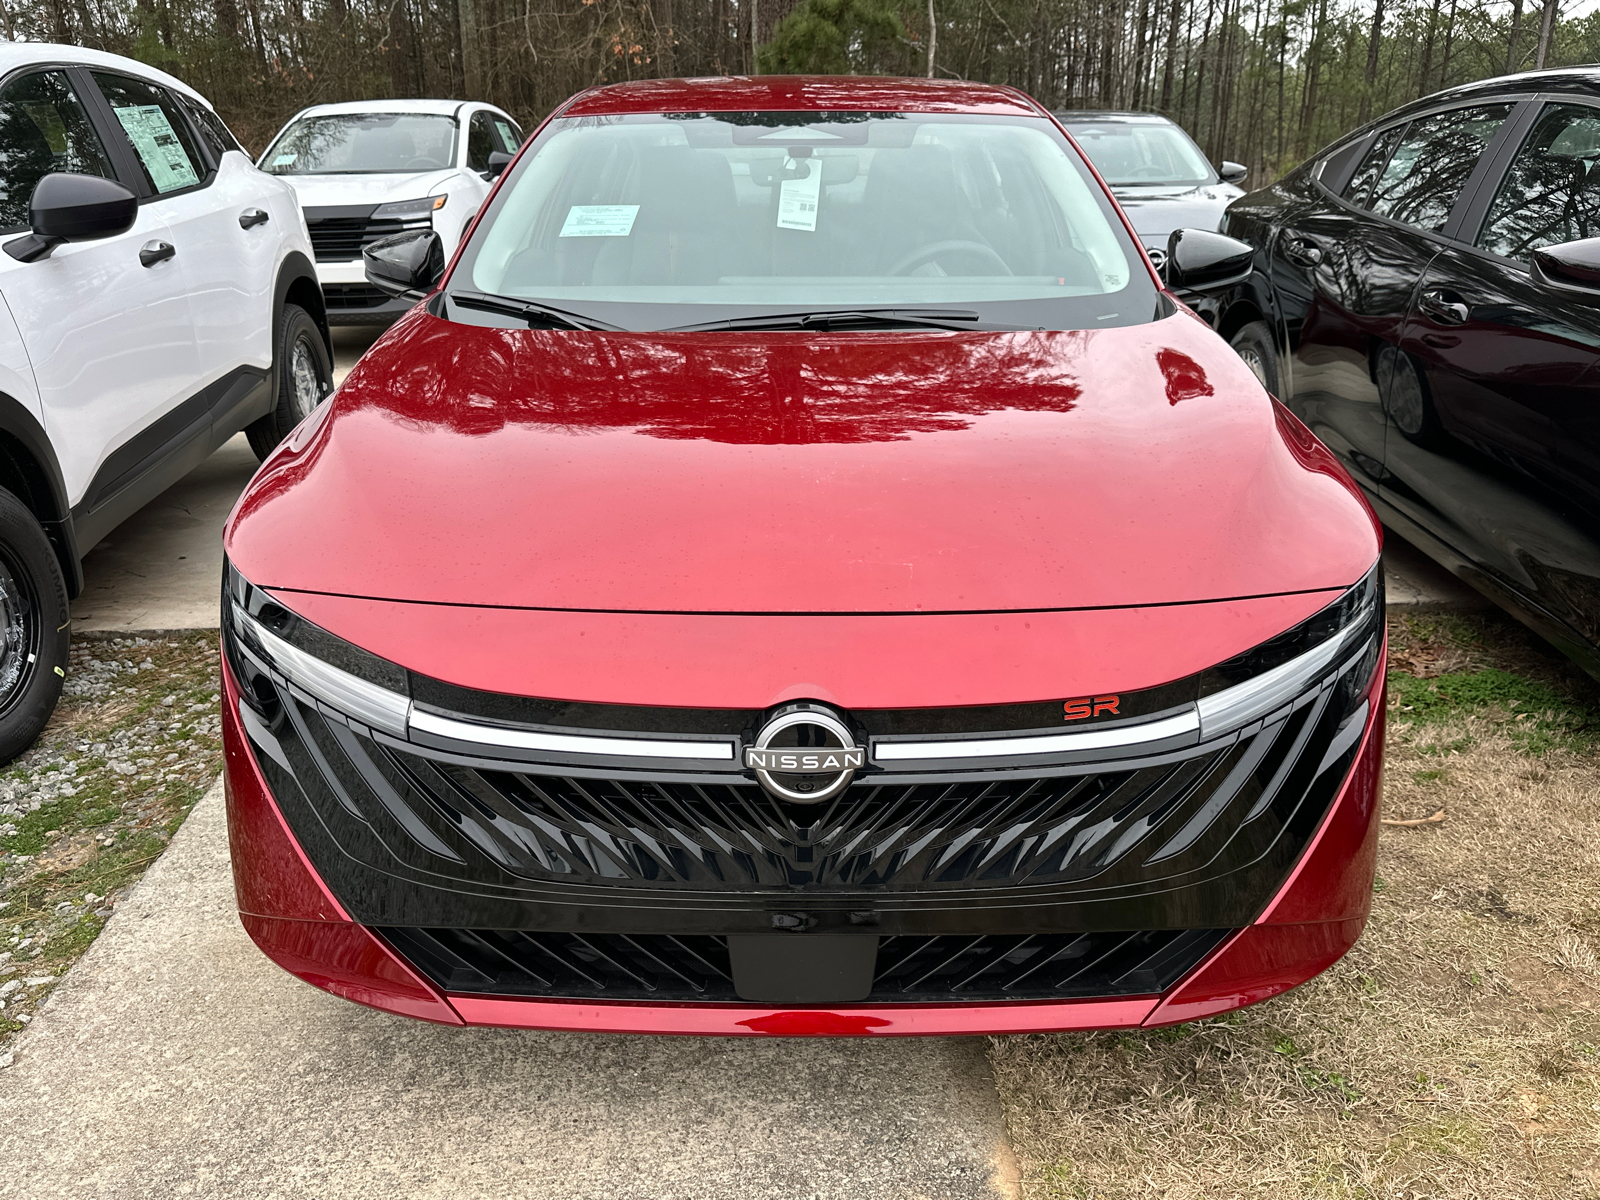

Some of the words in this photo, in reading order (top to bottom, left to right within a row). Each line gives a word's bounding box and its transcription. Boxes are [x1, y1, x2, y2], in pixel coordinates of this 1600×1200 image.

[42, 547, 67, 623] KUMHO
[1064, 695, 1120, 720] SR
[749, 752, 862, 769] NISSAN
